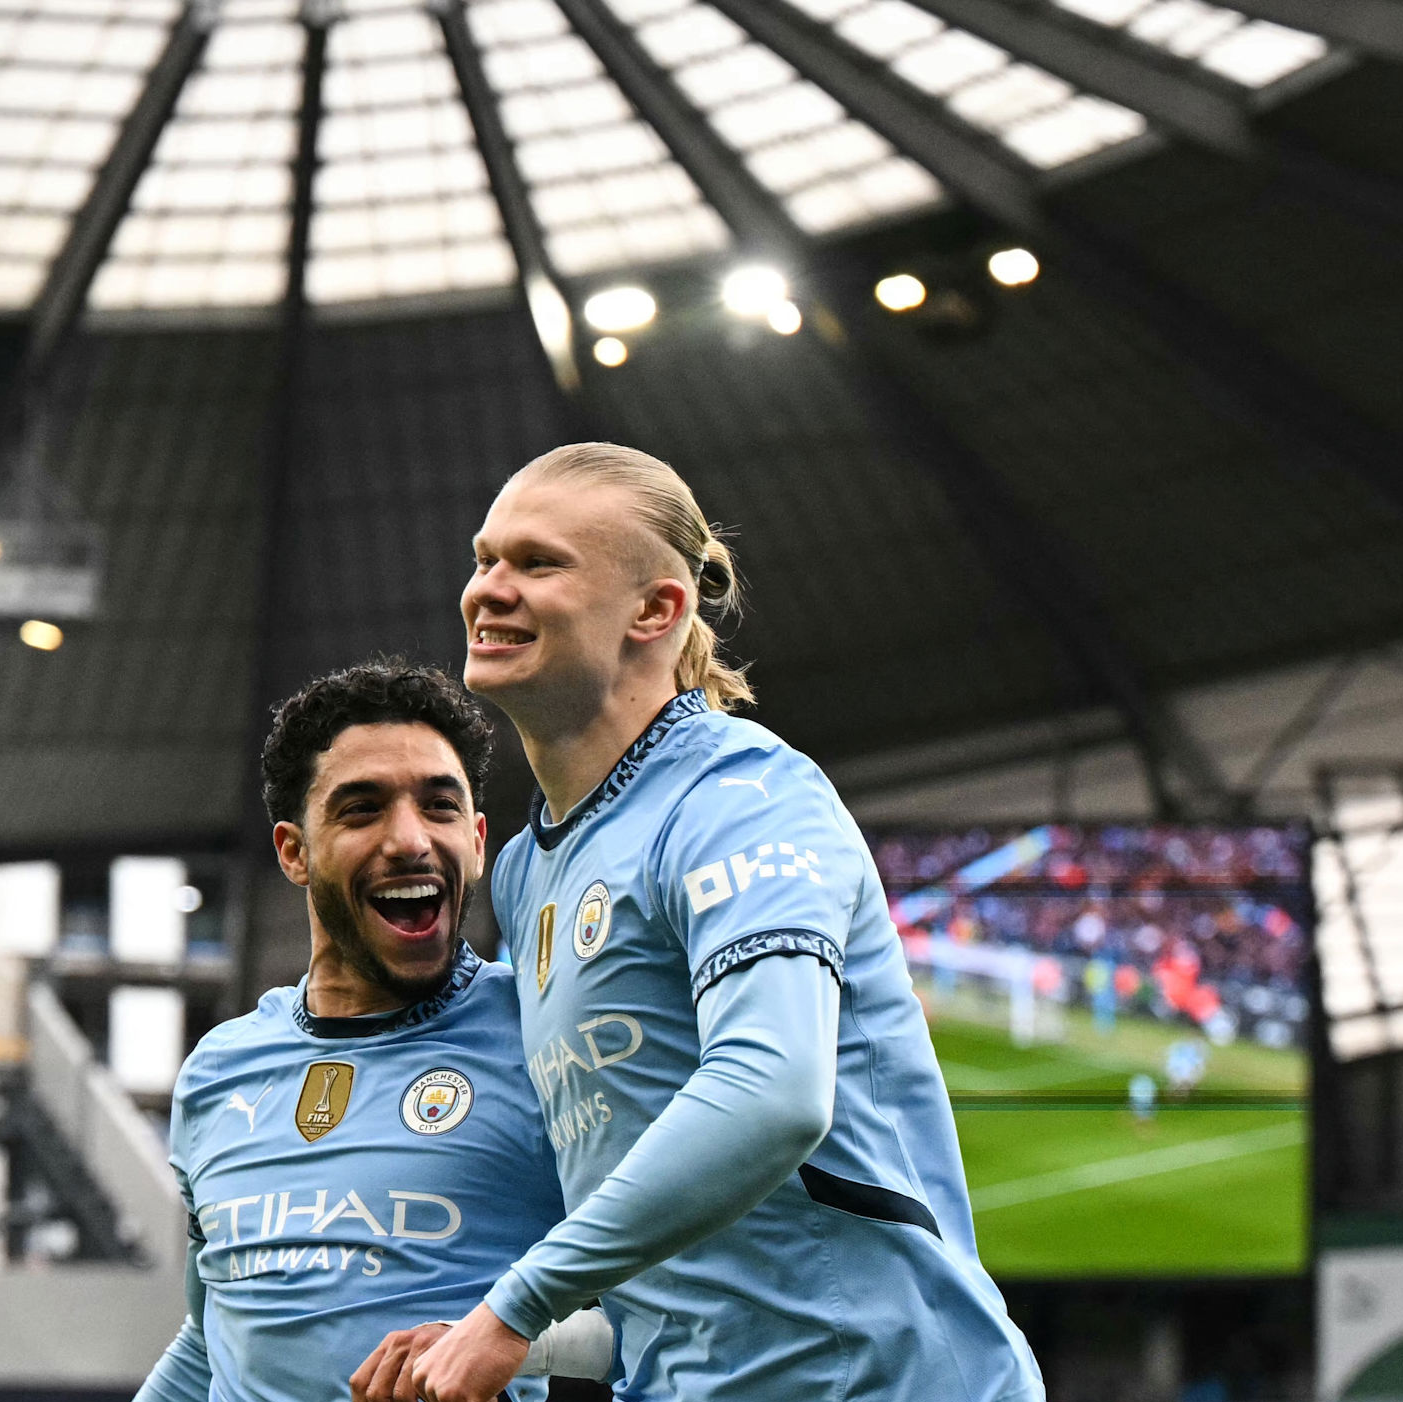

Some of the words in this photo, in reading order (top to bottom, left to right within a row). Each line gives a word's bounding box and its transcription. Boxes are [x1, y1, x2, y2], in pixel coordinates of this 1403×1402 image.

[682, 841, 823, 915] OKX
[413, 1073, 469, 1096] MANCHESTER
[306, 1113, 330, 1124] FIFA
[418, 1124, 440, 1132] CITY
[198, 1189, 462, 1248] ETIHAD
[229, 1247, 384, 1280] AIRWAYS
